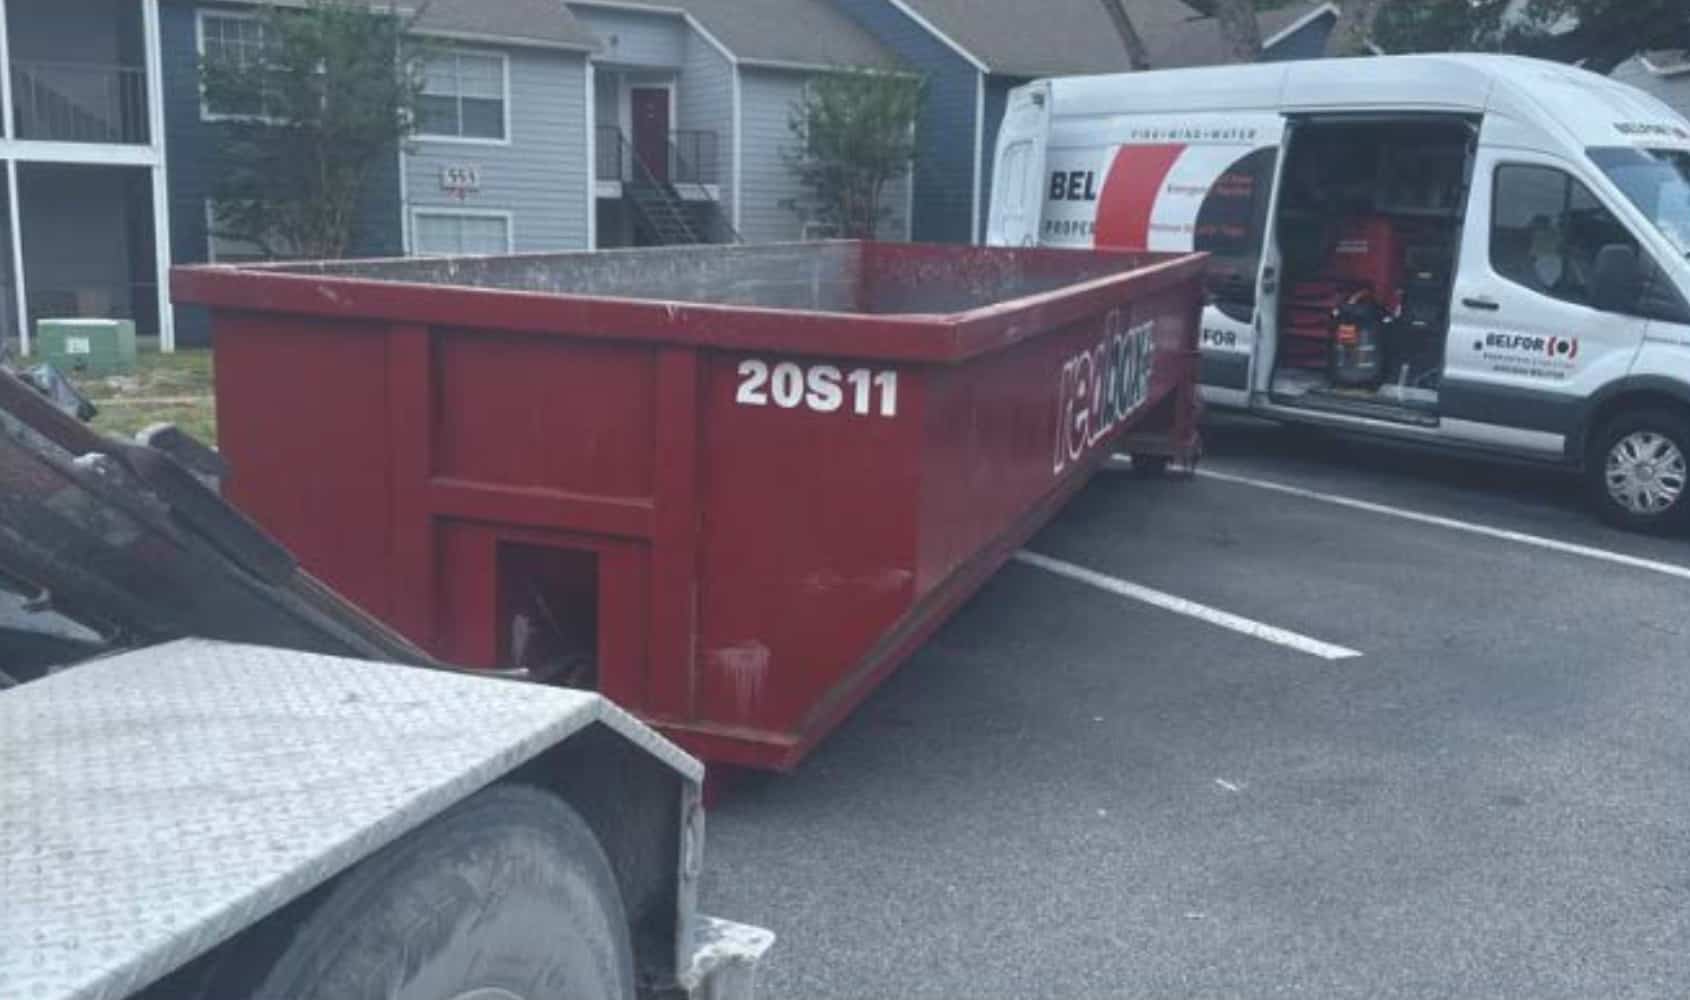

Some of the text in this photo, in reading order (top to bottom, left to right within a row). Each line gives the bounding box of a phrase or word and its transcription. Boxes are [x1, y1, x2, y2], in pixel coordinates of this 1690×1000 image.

[1049, 171, 1096, 201] BEL
[1203, 328, 1236, 346] FOR
[1486, 333, 1545, 351] BELFOR
[736, 359, 898, 417] 20S11
